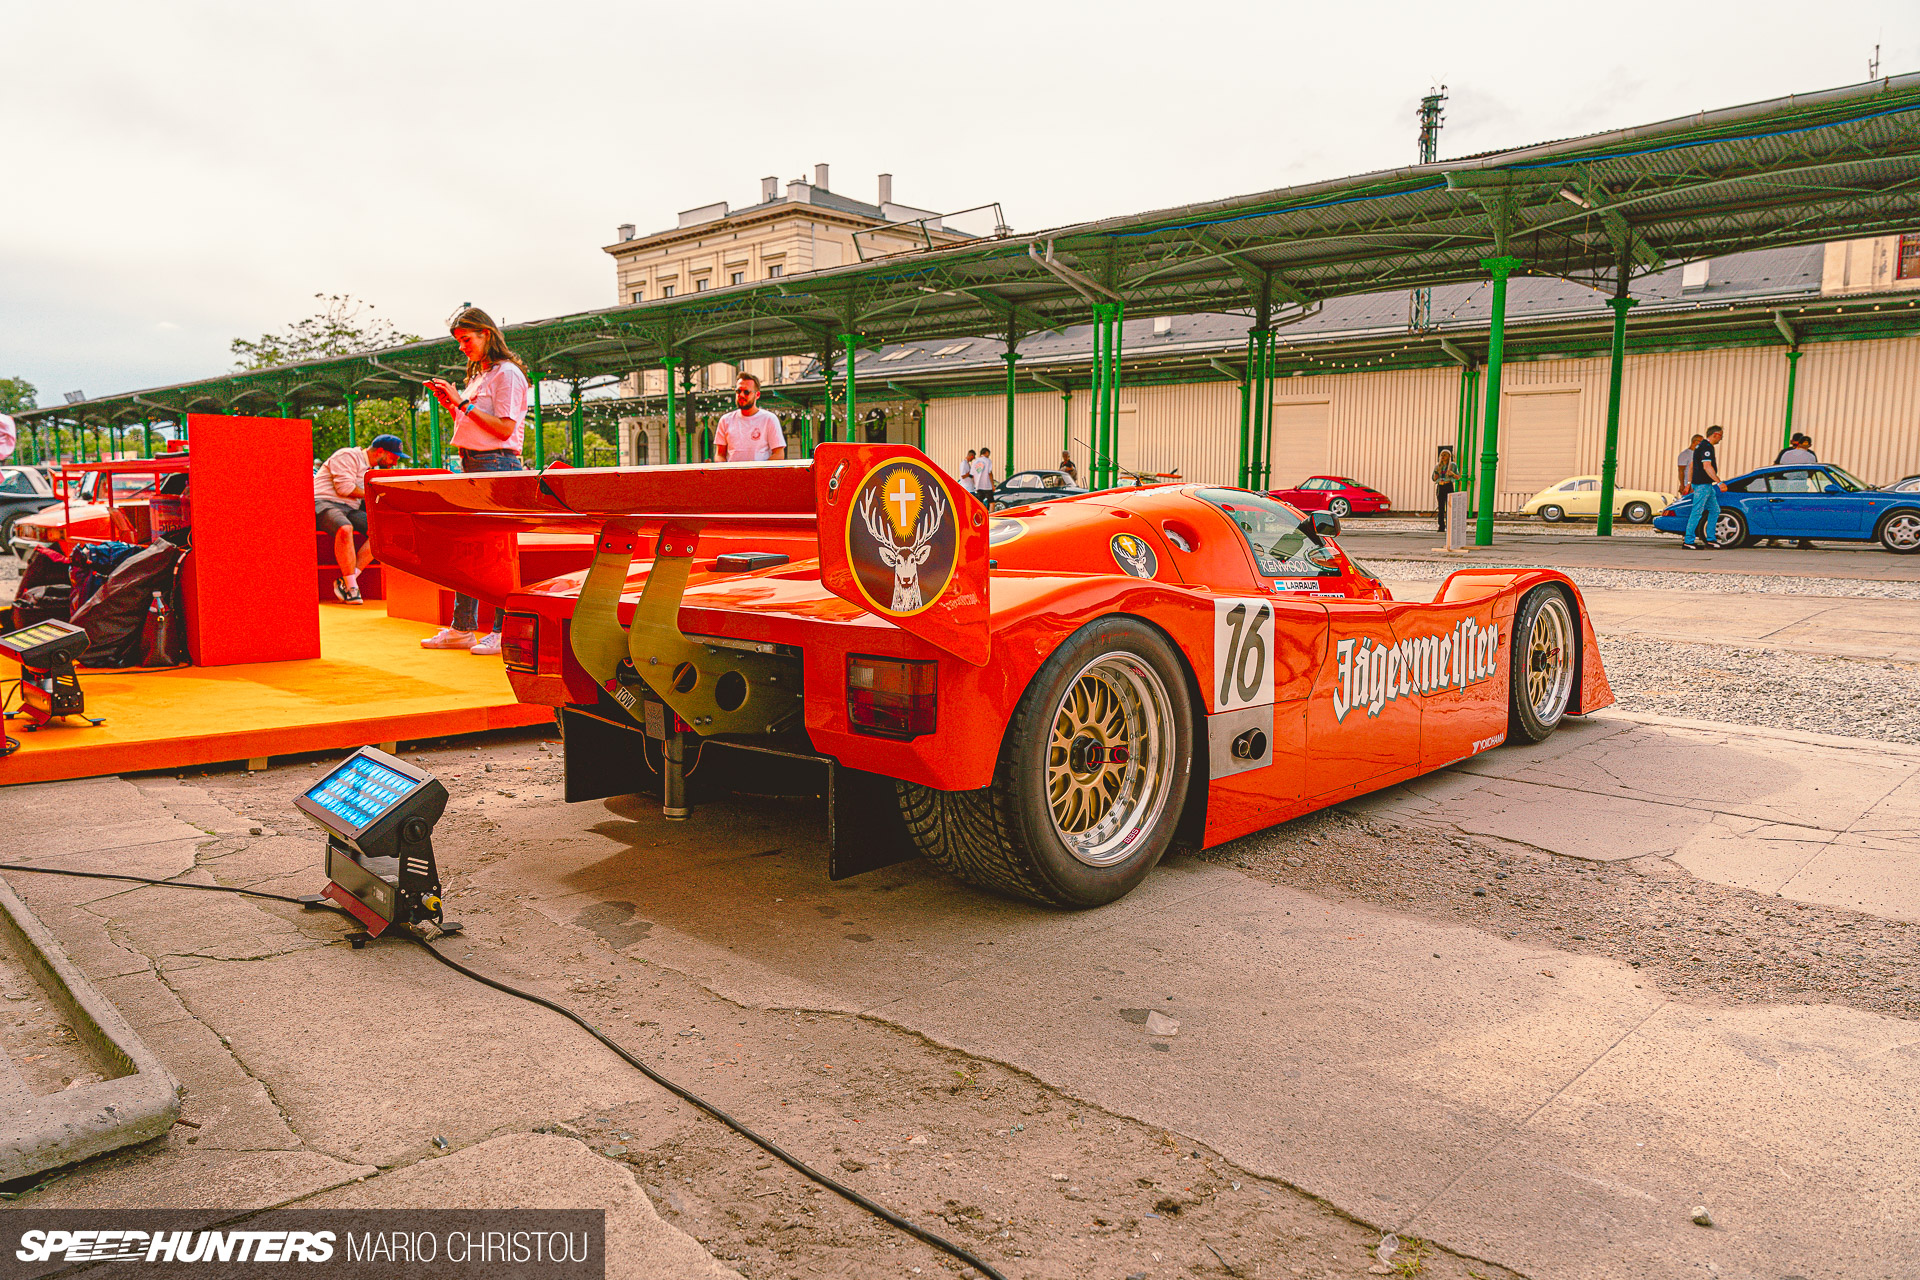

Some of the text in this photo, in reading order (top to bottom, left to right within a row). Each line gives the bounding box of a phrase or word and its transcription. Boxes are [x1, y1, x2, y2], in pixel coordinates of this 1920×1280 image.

[1260, 560, 1308, 572] KENWOOD
[1285, 580, 1319, 590] LARRAURI
[1220, 602, 1270, 707] 16
[616, 687, 635, 708] TOW
[1123, 828, 1139, 844] BBS
